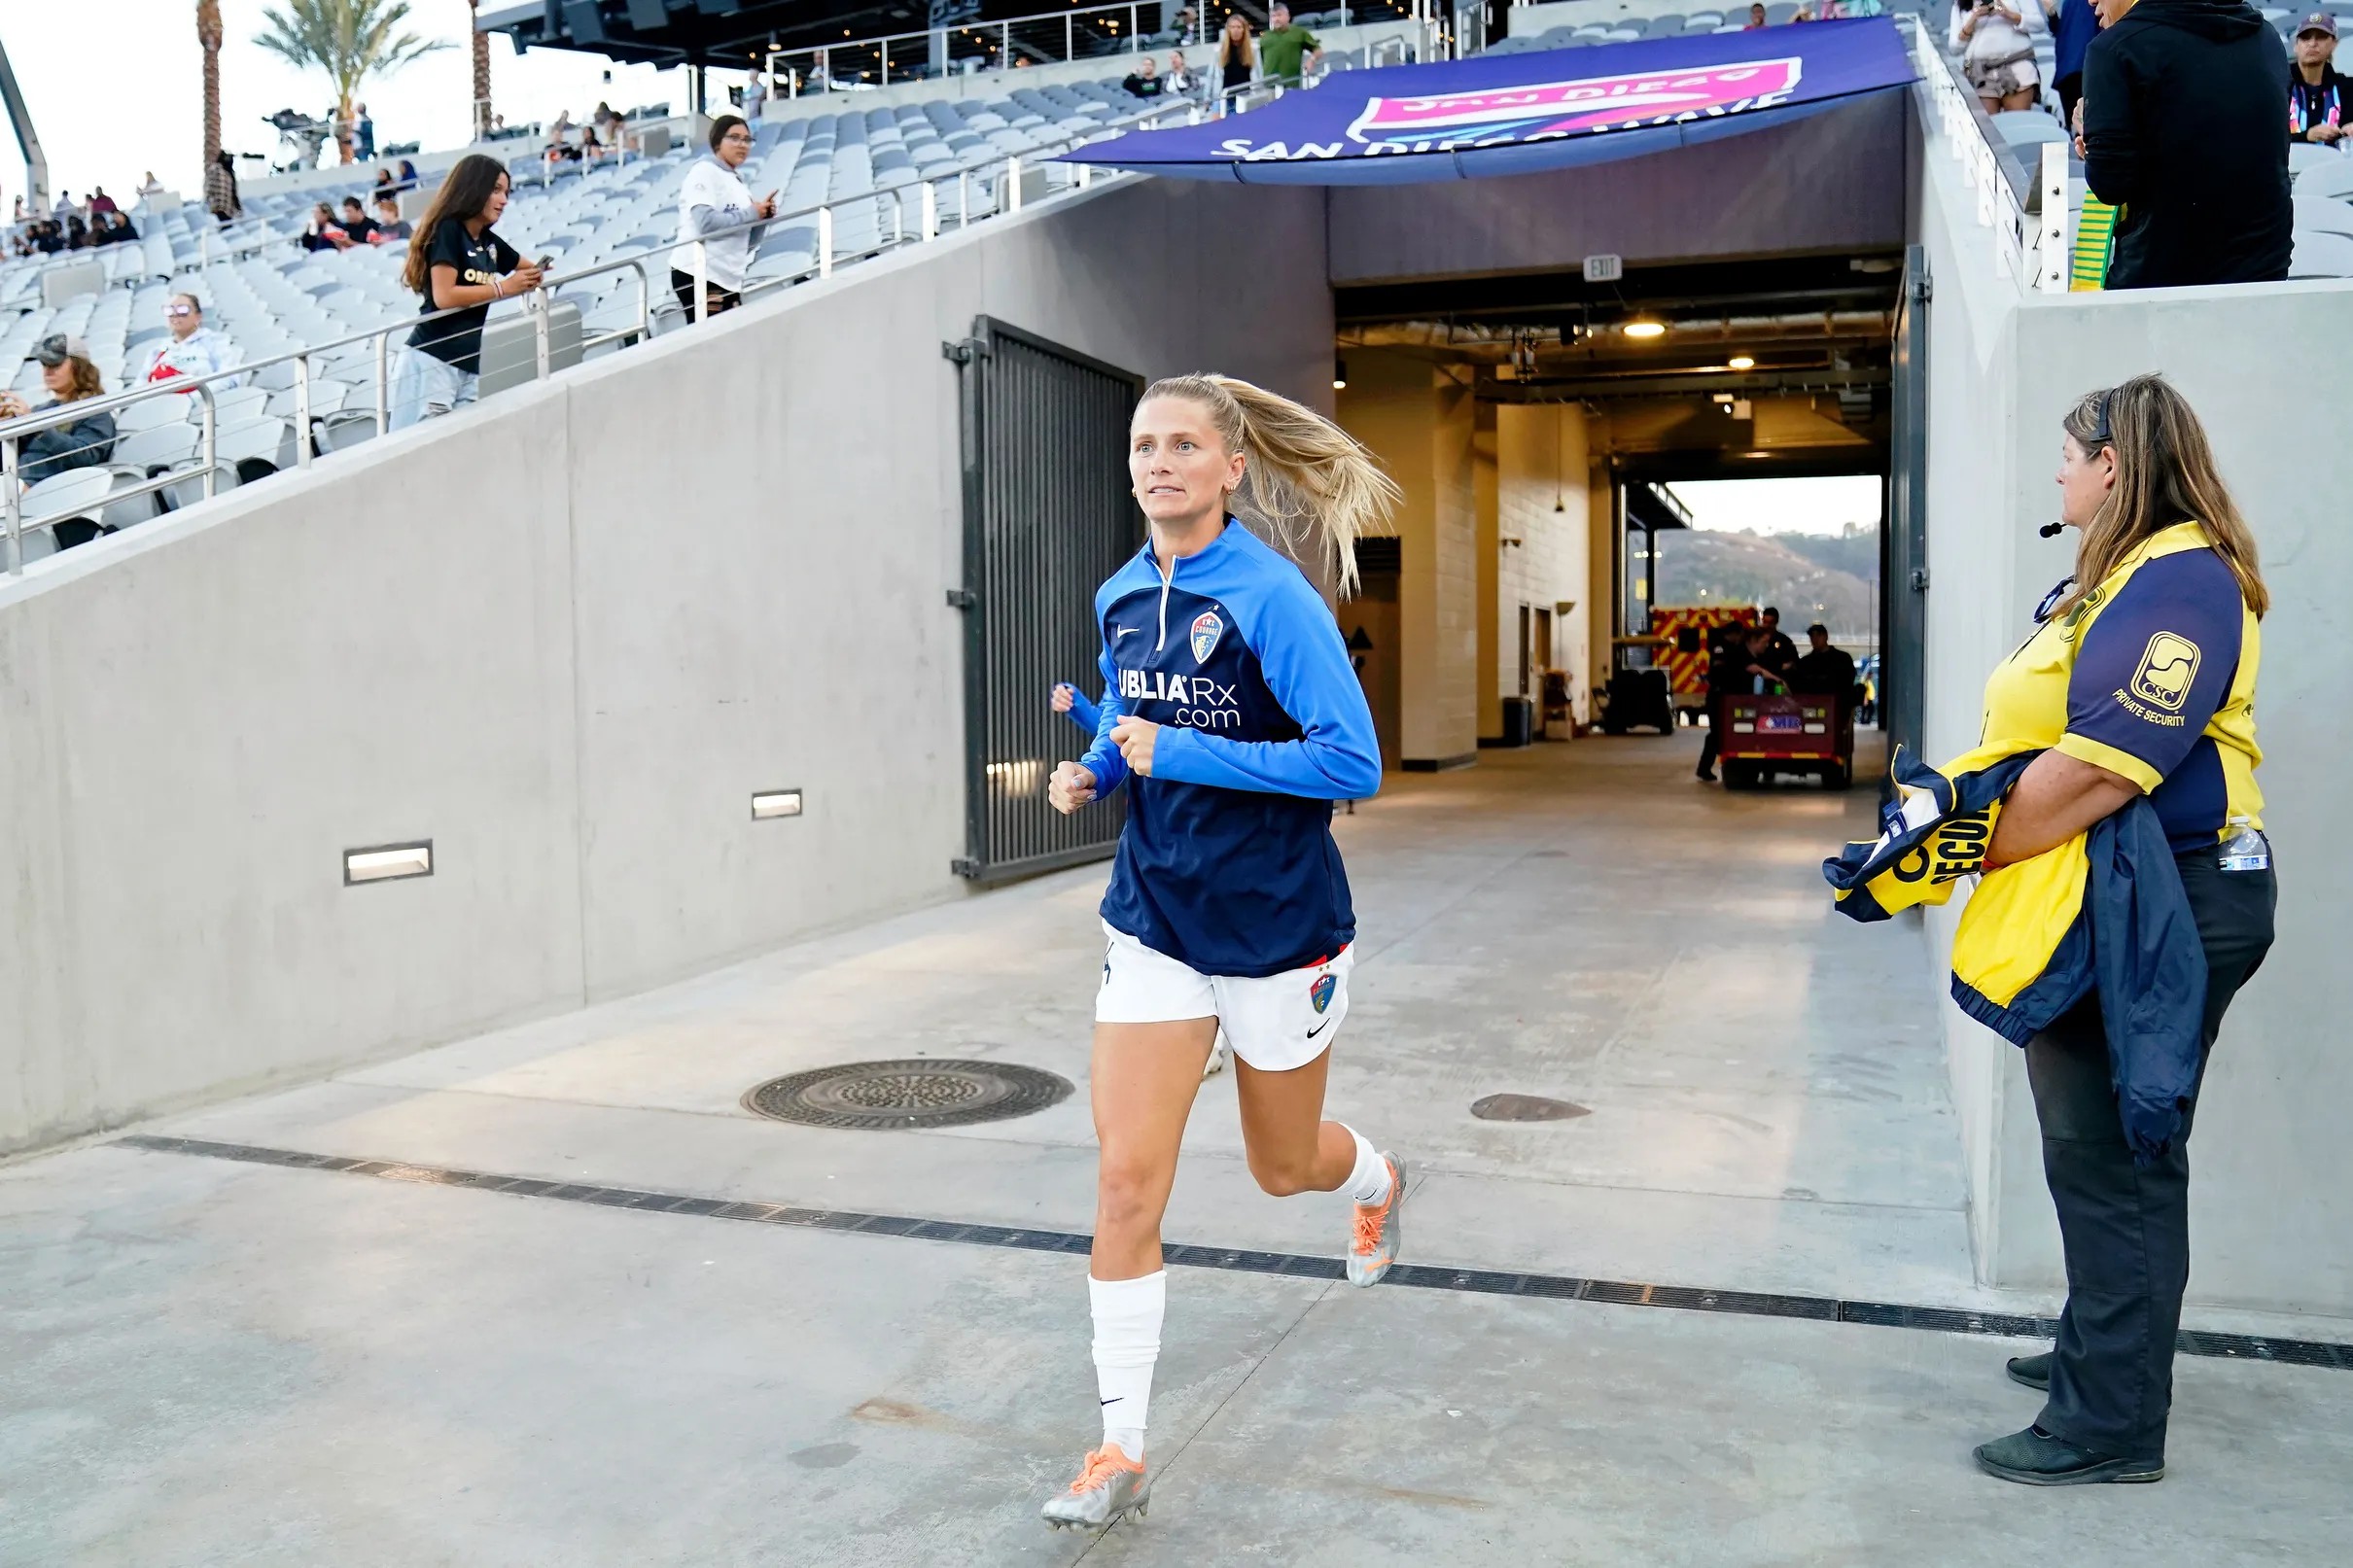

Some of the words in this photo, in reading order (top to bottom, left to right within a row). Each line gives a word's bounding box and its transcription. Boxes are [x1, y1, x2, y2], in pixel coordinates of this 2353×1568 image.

[1210, 139, 1344, 160] SAN
[2141, 681, 2175, 704] CSC
[1174, 708, 1241, 728] .com
[2111, 688, 2146, 717] PRIVATE
[2143, 710, 2186, 727] SECURITY
